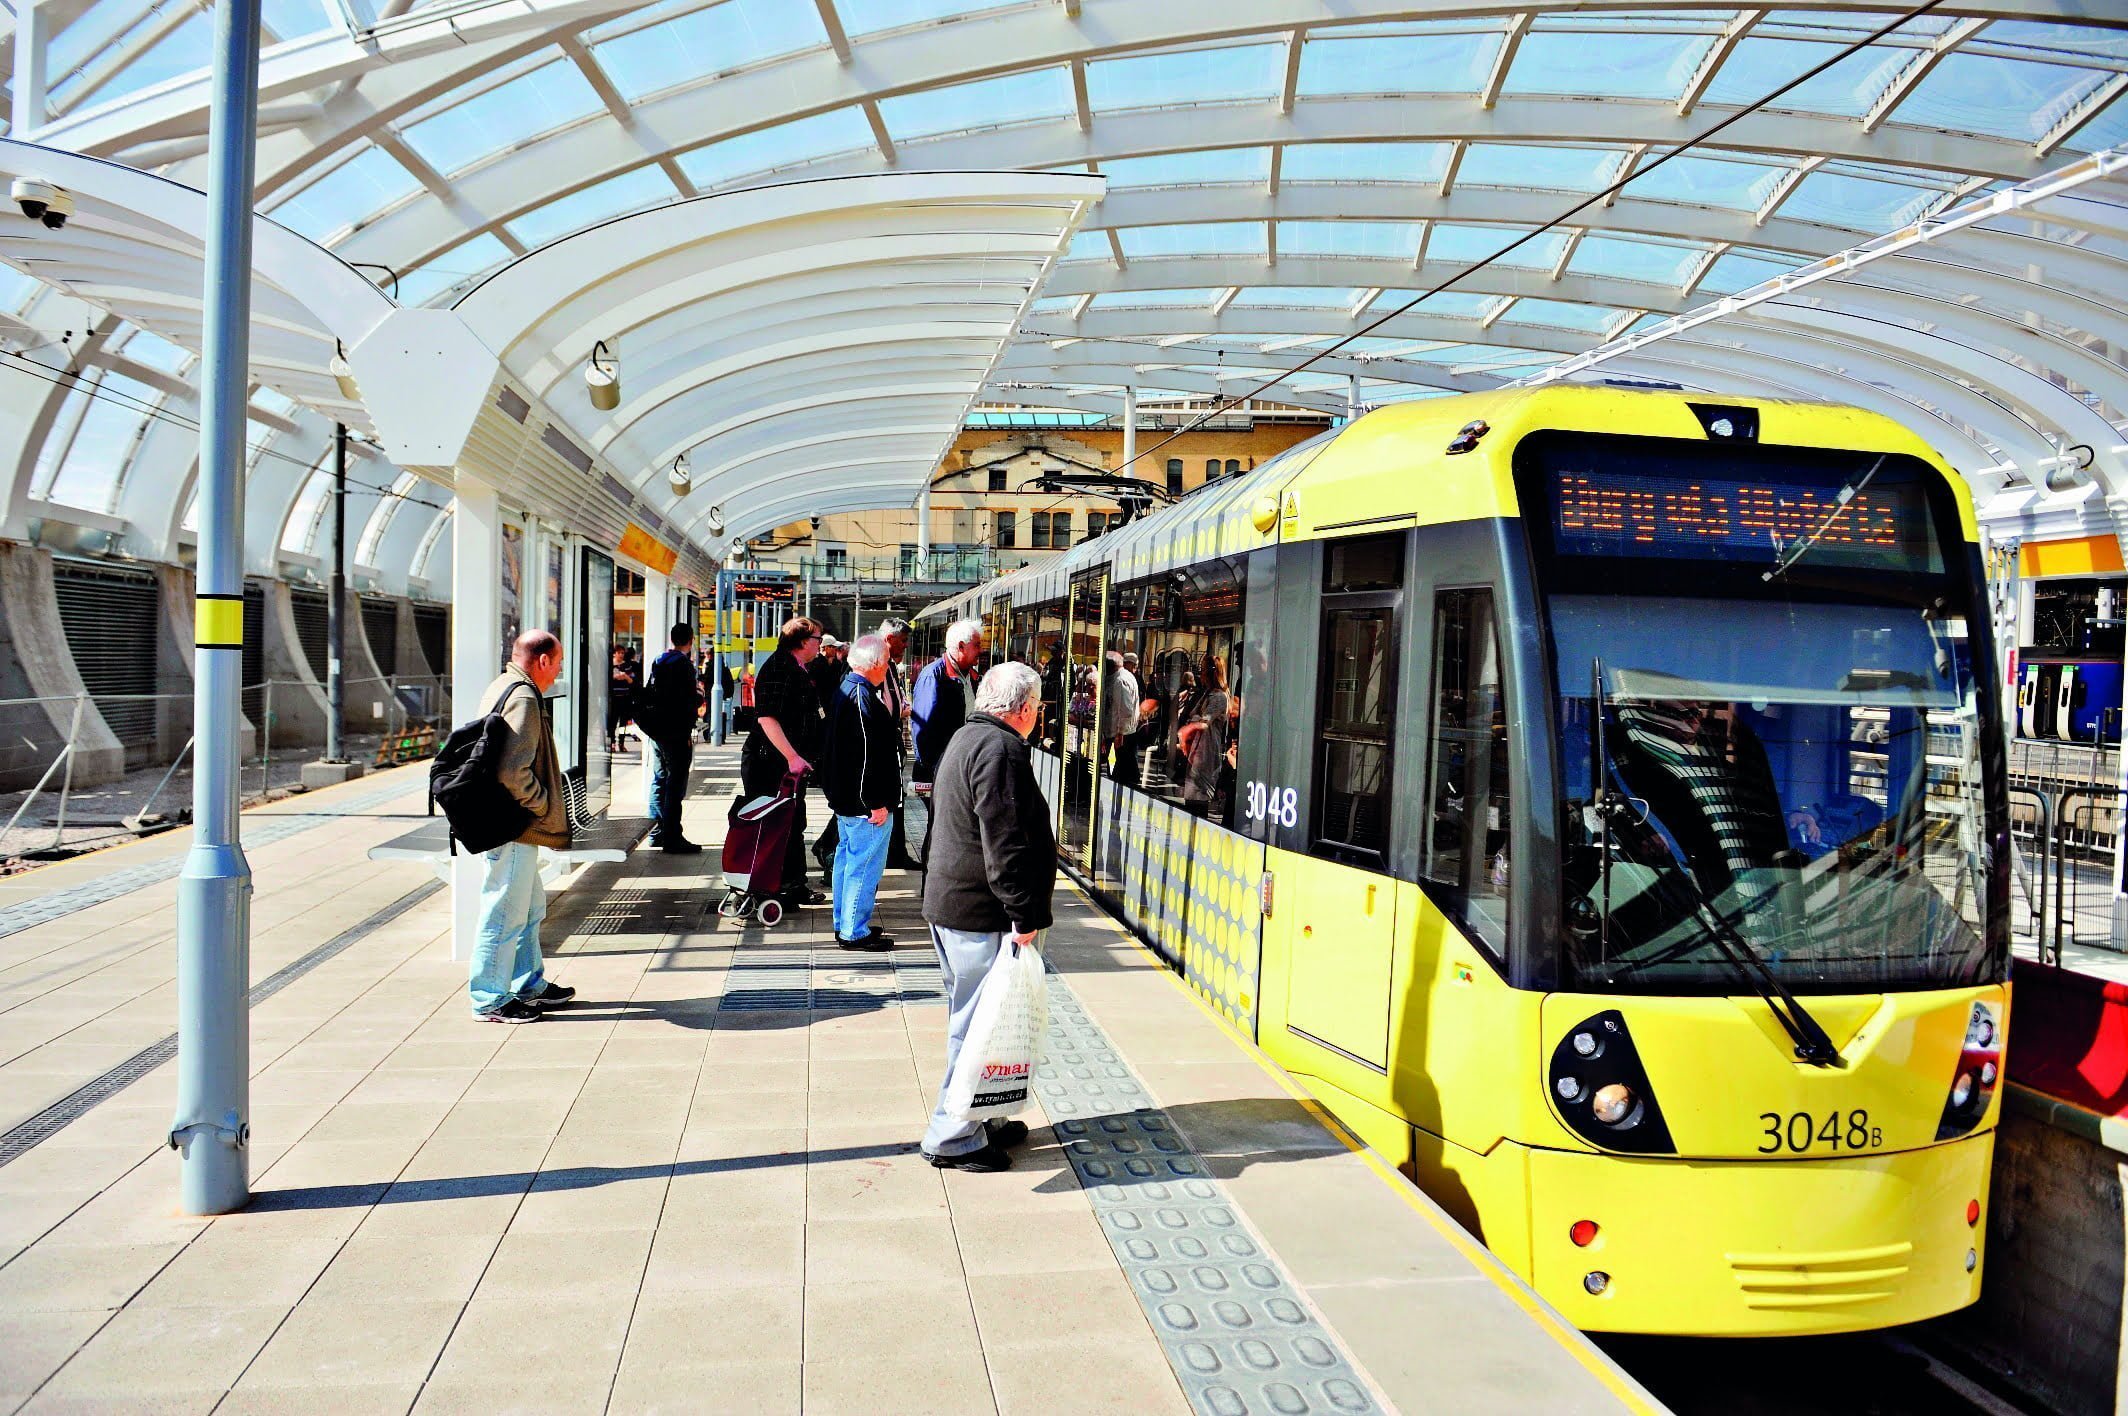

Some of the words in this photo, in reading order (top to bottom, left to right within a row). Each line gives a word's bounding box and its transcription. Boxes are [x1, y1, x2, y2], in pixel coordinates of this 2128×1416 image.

[1665, 486, 1730, 534] via
[1245, 780, 1298, 828] 3048
[1757, 1109, 1883, 1154] 3048B
